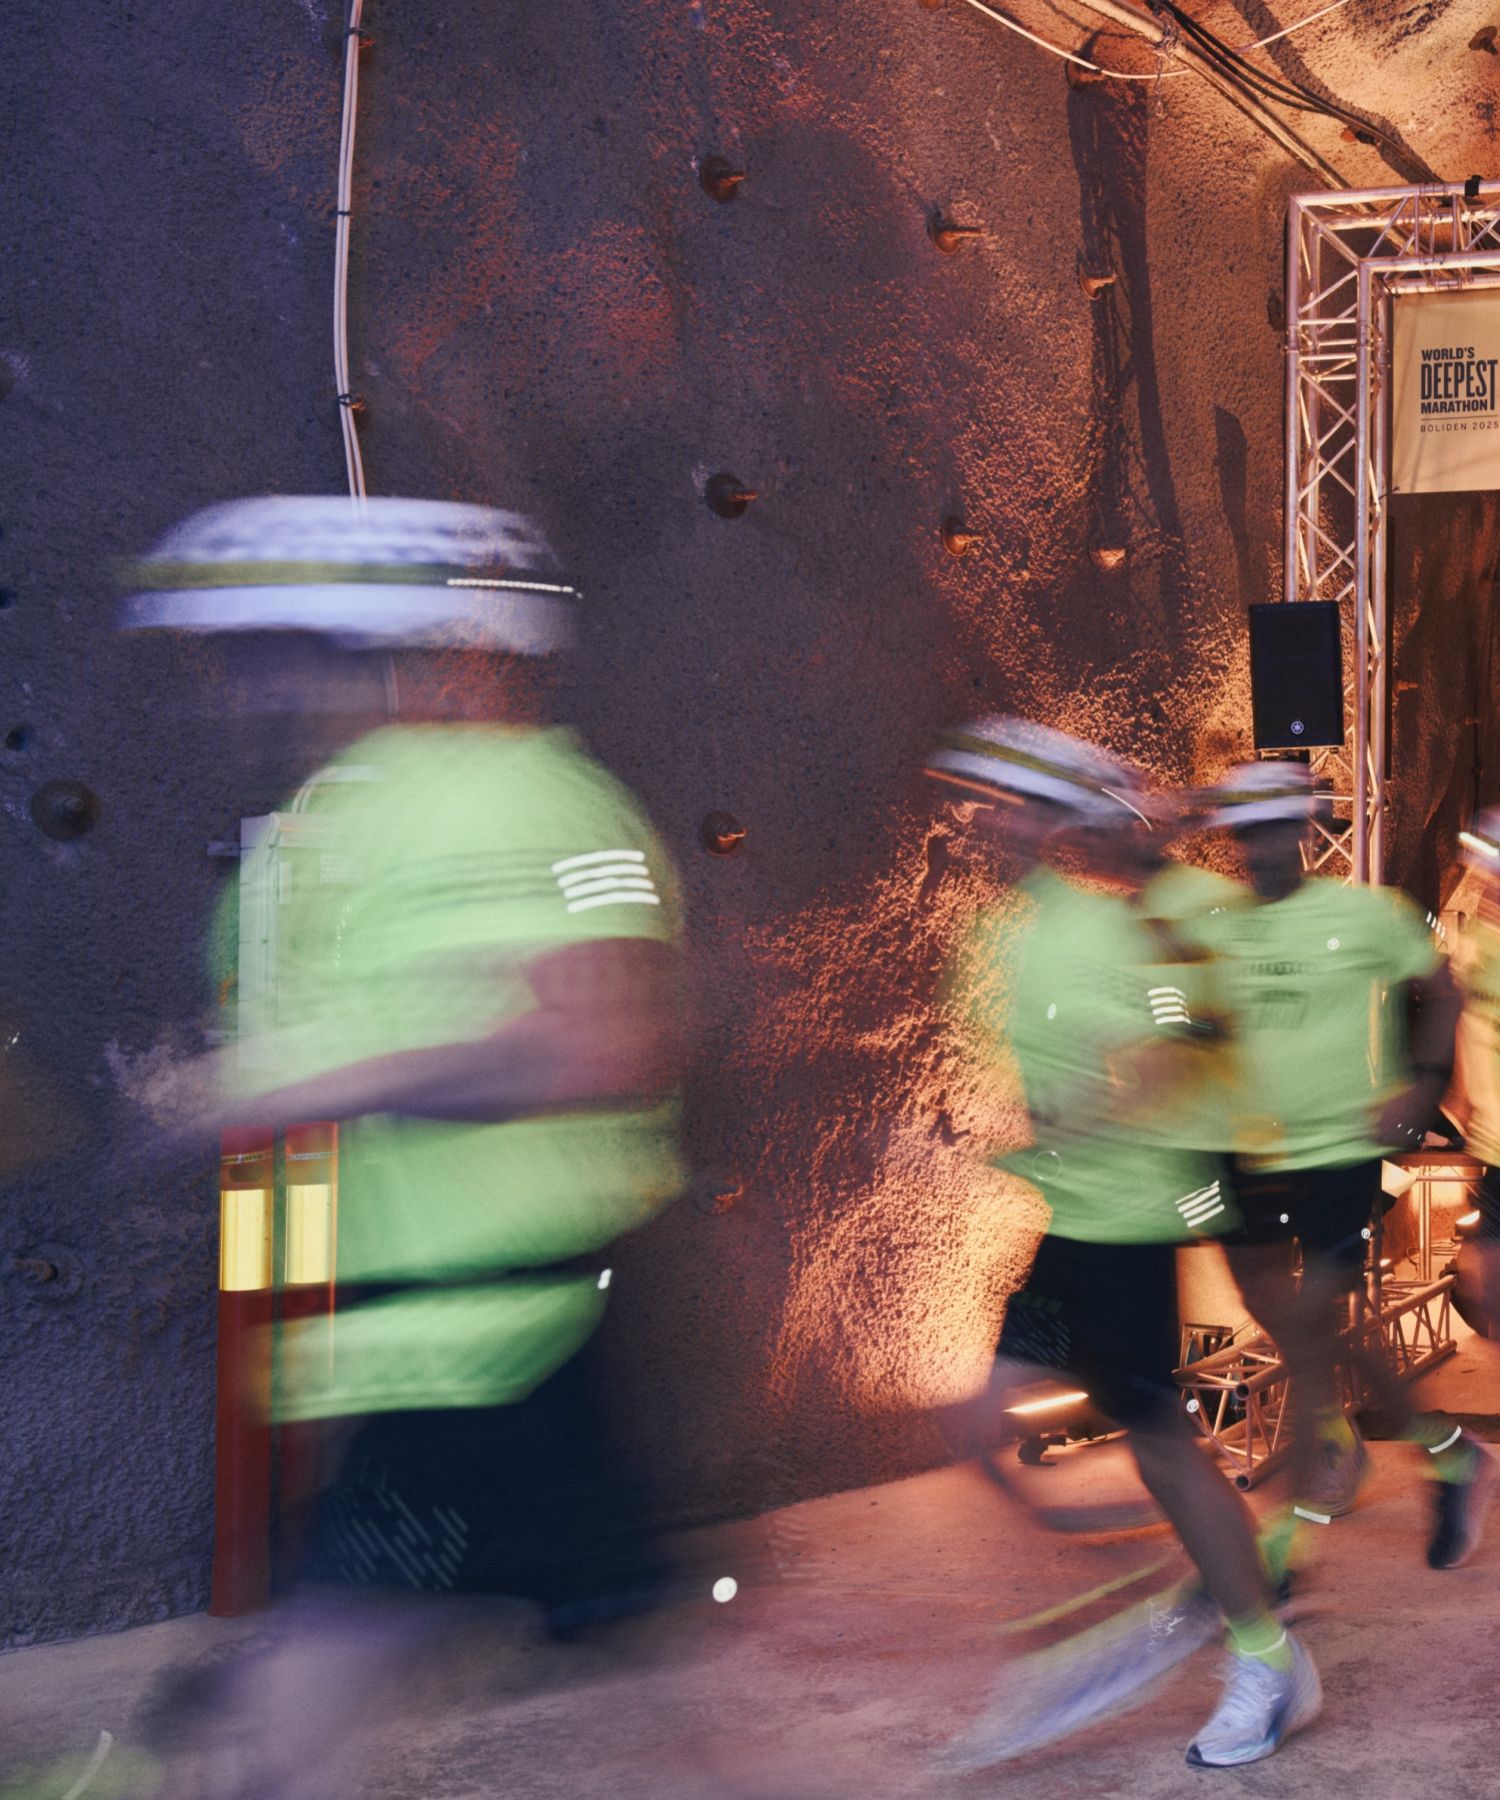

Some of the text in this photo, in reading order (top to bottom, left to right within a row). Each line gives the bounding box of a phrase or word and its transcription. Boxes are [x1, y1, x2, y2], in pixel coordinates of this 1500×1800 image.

[1421, 346, 1475, 361] WORLD'S
[1420, 359, 1498, 411] DEEPEST
[1420, 399, 1488, 414] MARATHON
[1420, 420, 1499, 433] BOLIDEN 2025
